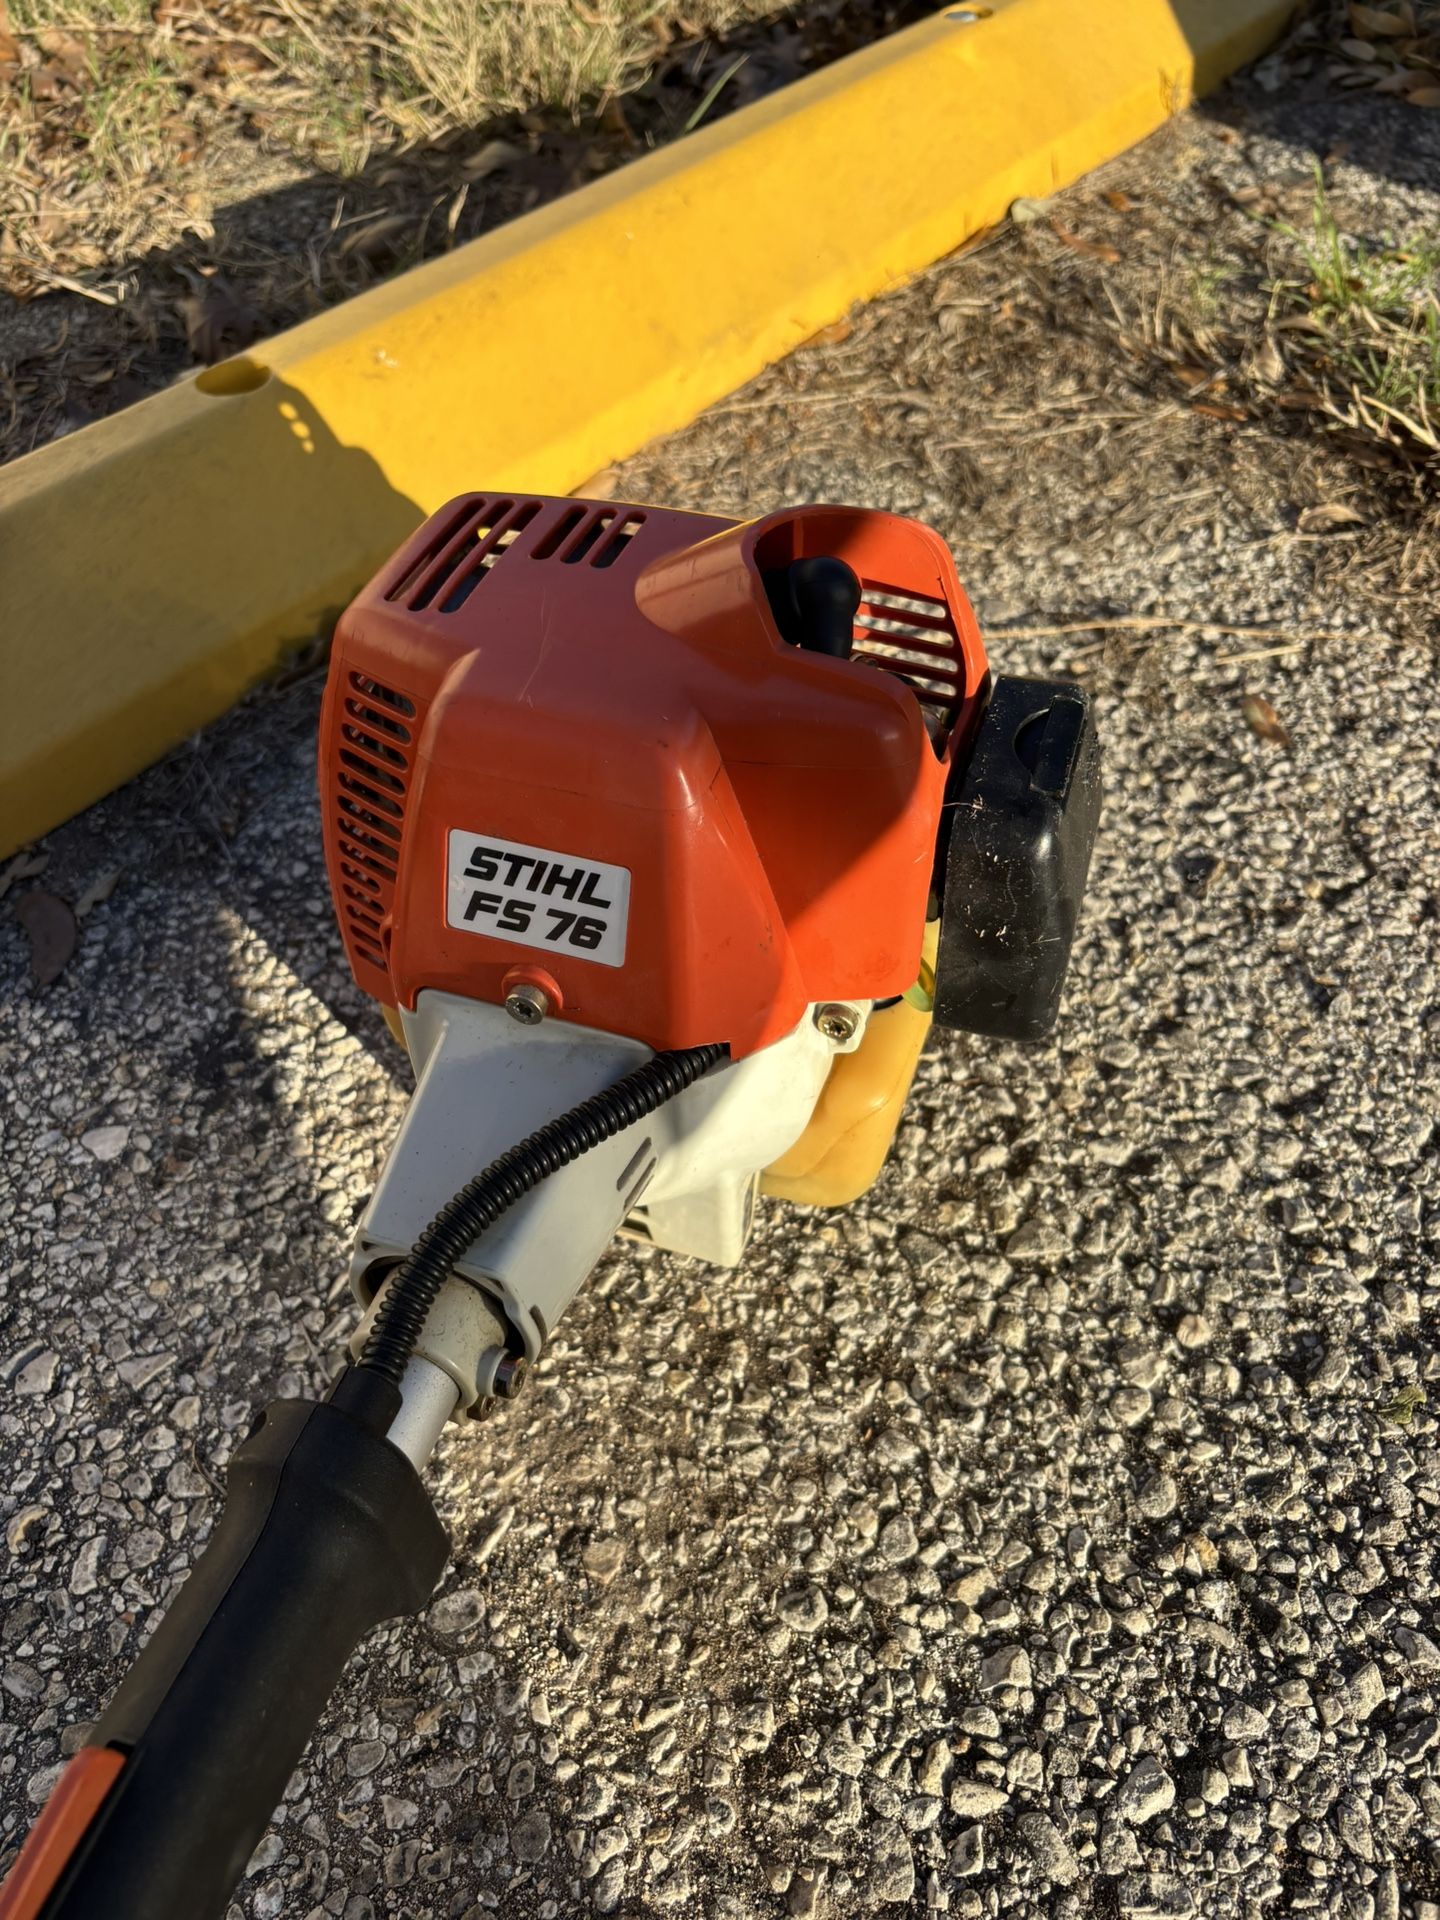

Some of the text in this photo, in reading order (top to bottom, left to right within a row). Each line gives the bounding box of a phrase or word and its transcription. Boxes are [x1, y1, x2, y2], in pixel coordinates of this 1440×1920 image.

[463, 846, 611, 909] STIHL
[463, 890, 607, 949] FS 76
